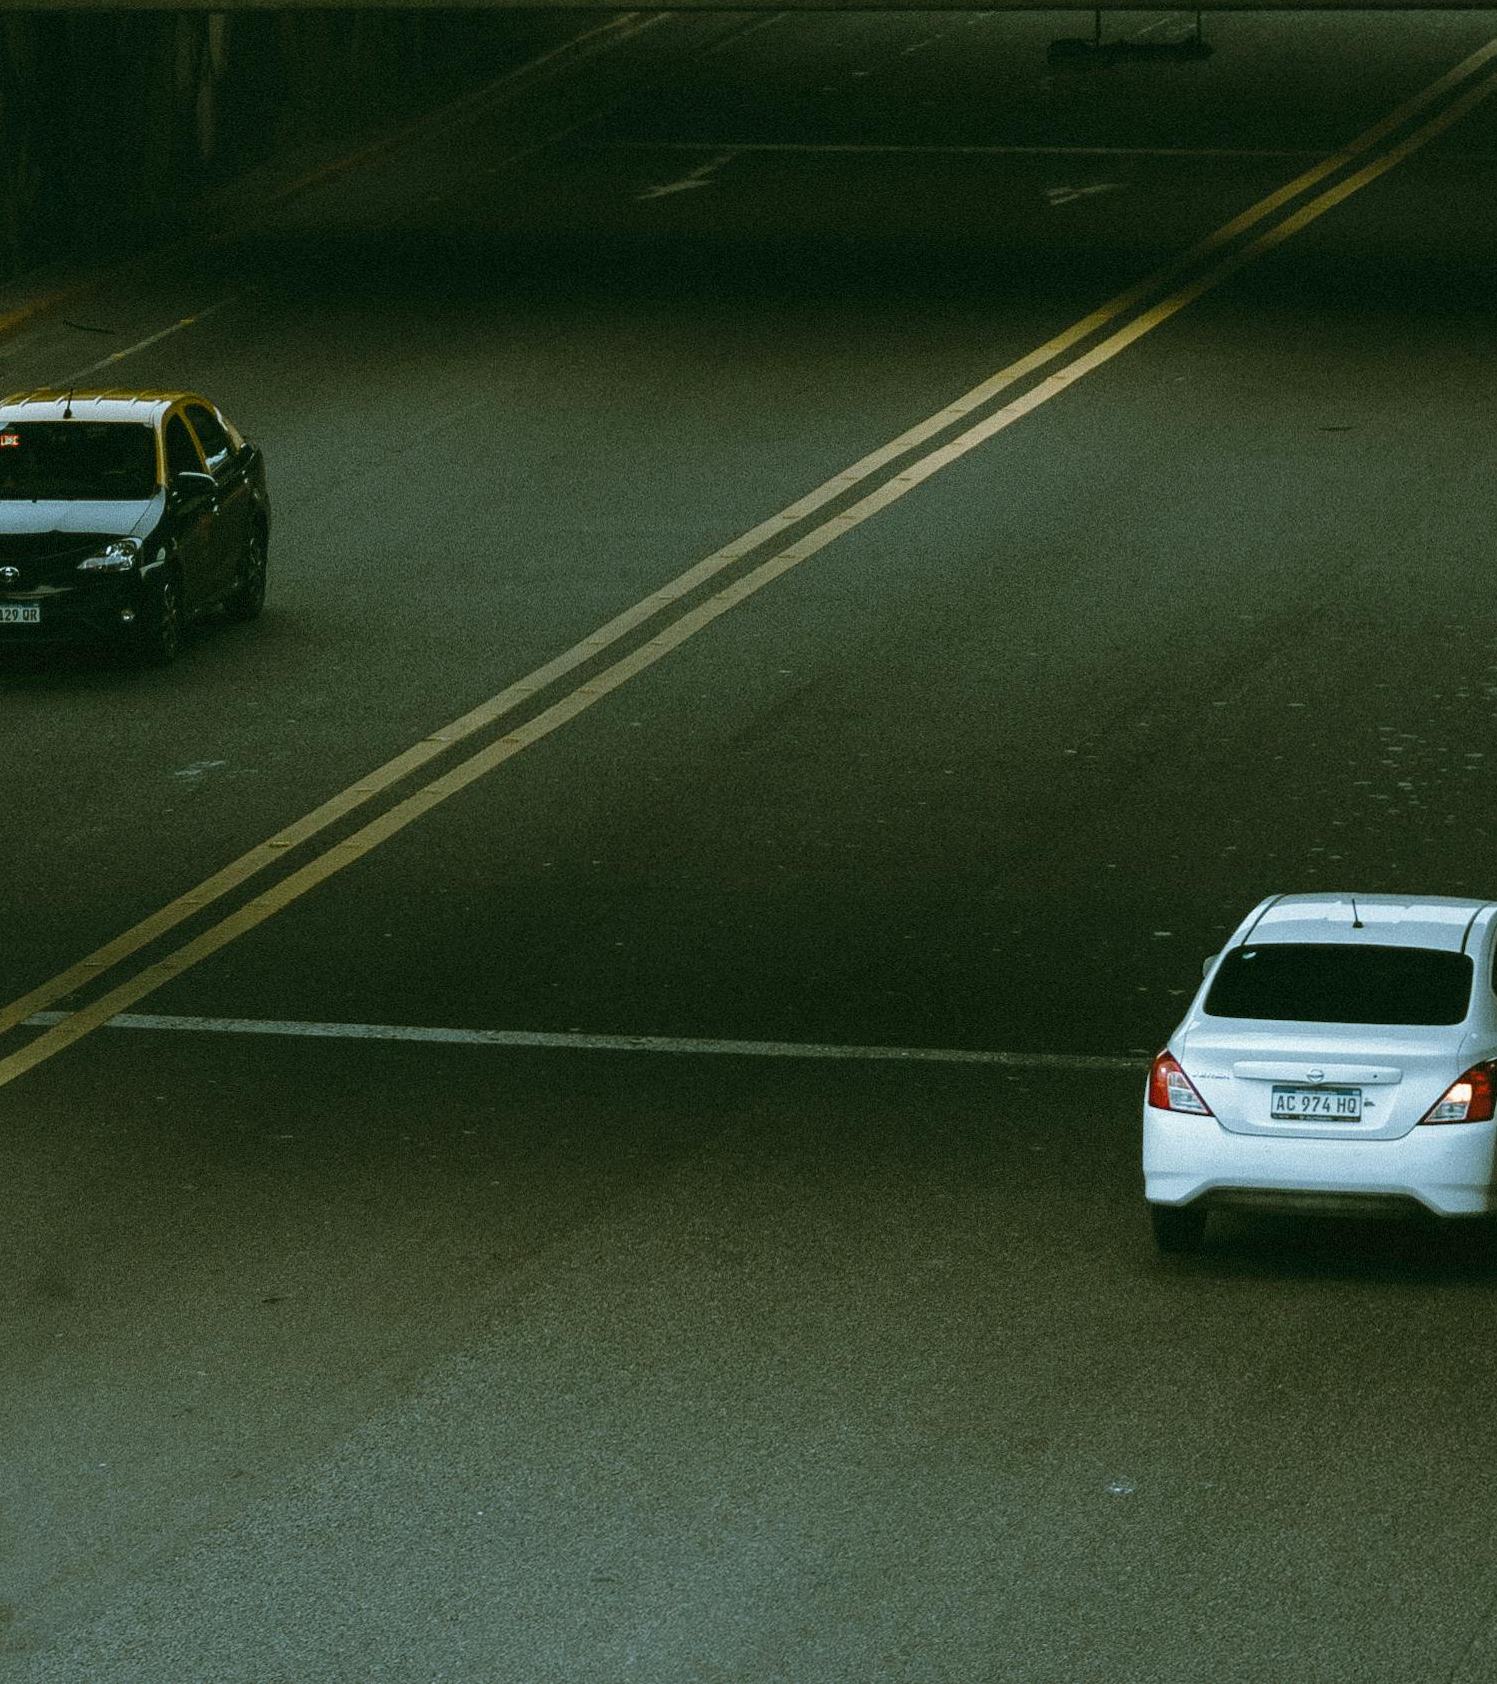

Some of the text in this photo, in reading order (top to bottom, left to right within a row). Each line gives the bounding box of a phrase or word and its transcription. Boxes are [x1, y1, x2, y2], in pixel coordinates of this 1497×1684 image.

[1276, 1095, 1357, 1114] AC 974 HQ
